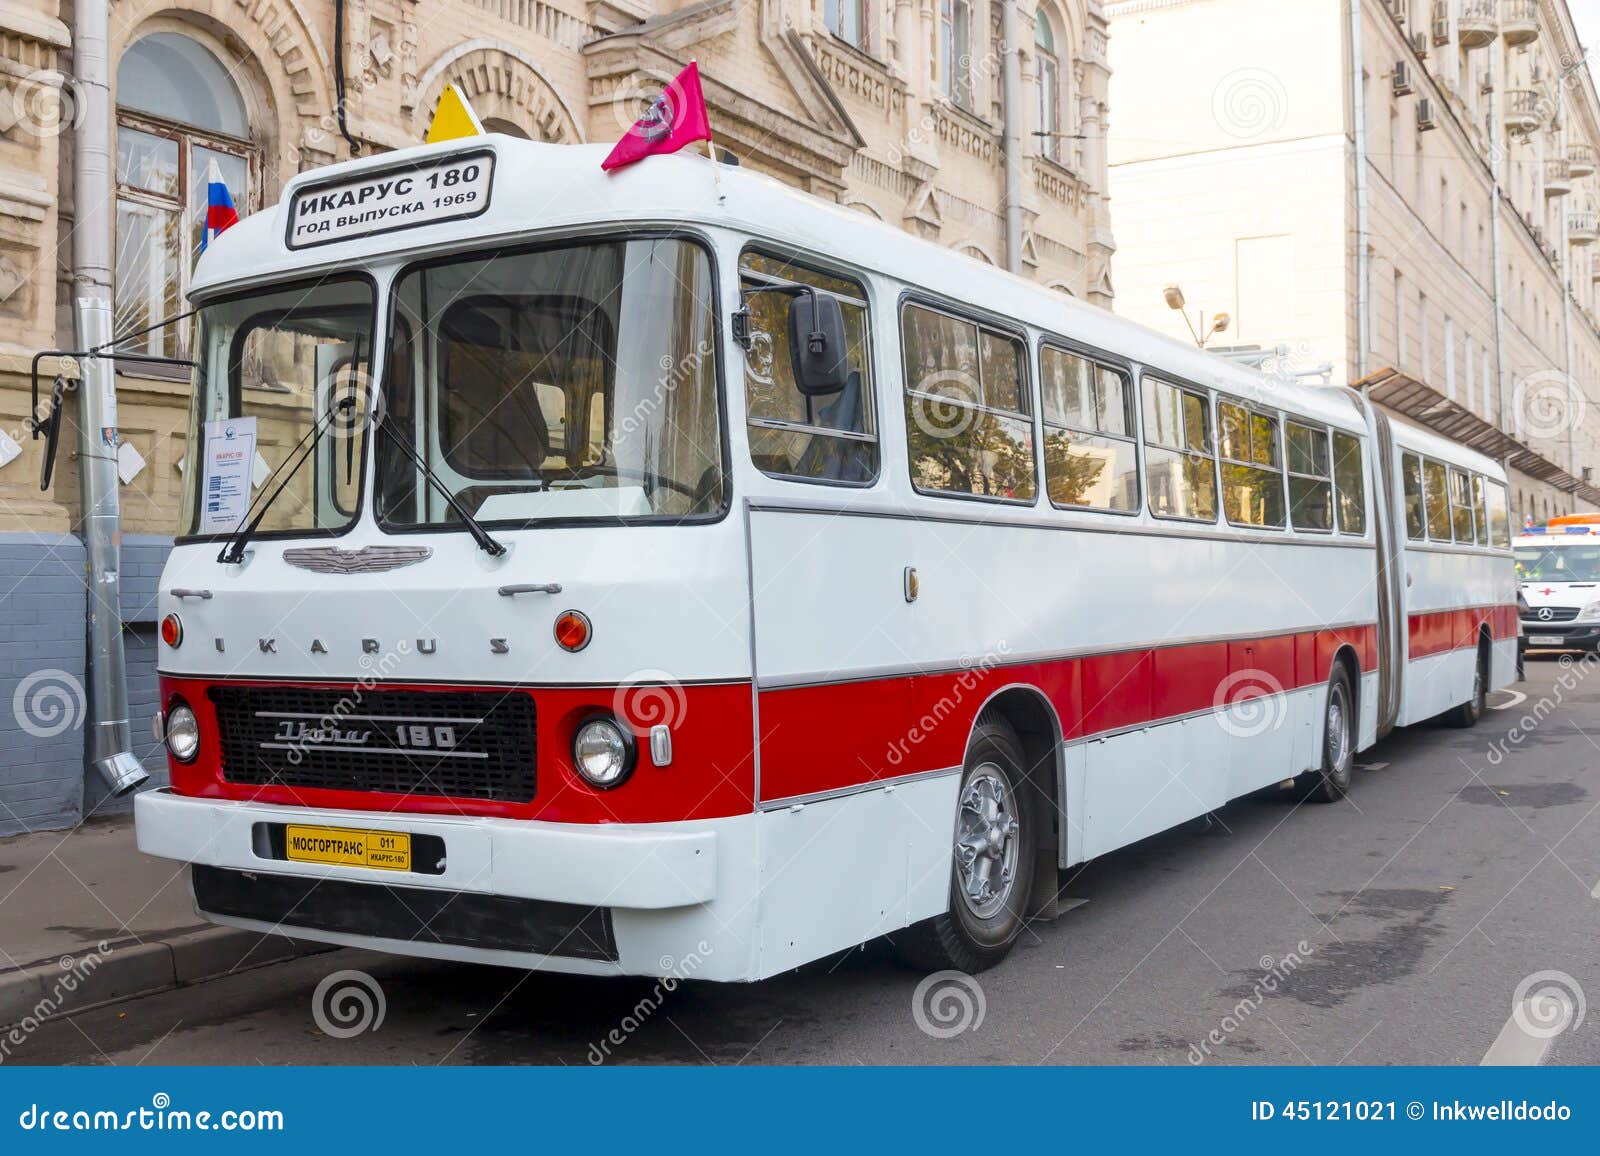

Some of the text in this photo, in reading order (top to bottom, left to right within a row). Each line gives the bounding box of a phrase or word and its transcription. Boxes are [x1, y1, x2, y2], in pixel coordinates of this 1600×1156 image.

[299, 165, 480, 217] ИКАРУС 180
[297, 191, 477, 236] ГОД ВЫПУСКА 1969
[214, 637, 510, 654] IKARUS
[395, 725, 456, 748] 180
[293, 837, 363, 855] МОСГОРТРАНС
[380, 838, 395, 849] 011
